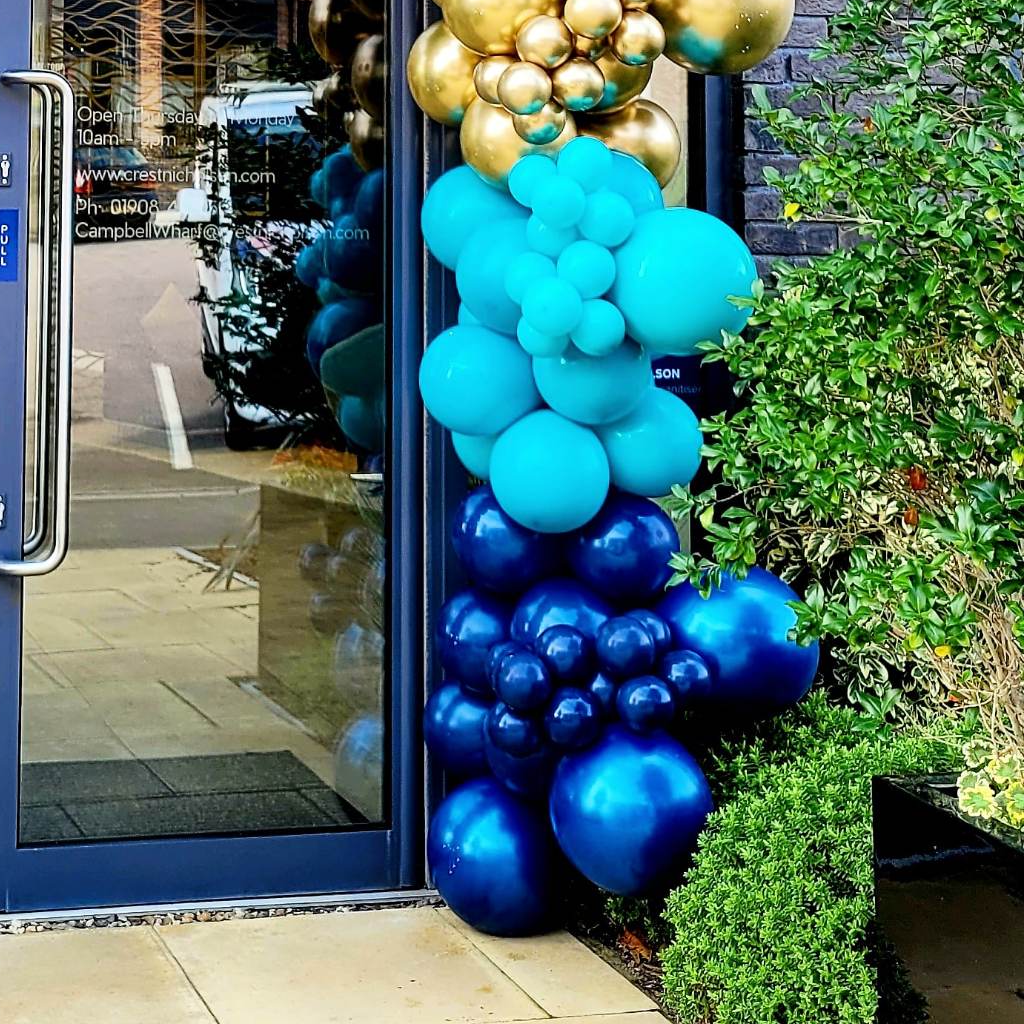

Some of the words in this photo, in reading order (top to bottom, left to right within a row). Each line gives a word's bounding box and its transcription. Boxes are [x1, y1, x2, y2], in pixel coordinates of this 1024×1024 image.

[77, 106, 123, 125] Open
[130, 107, 199, 125] Trsday
[76, 129, 119, 145] 10am
[77, 166, 275, 184] www.crestnichsn.com
[111, 199, 159, 215] 01908
[0, 224, 9, 266] PULL
[653, 368, 680, 379] SON
